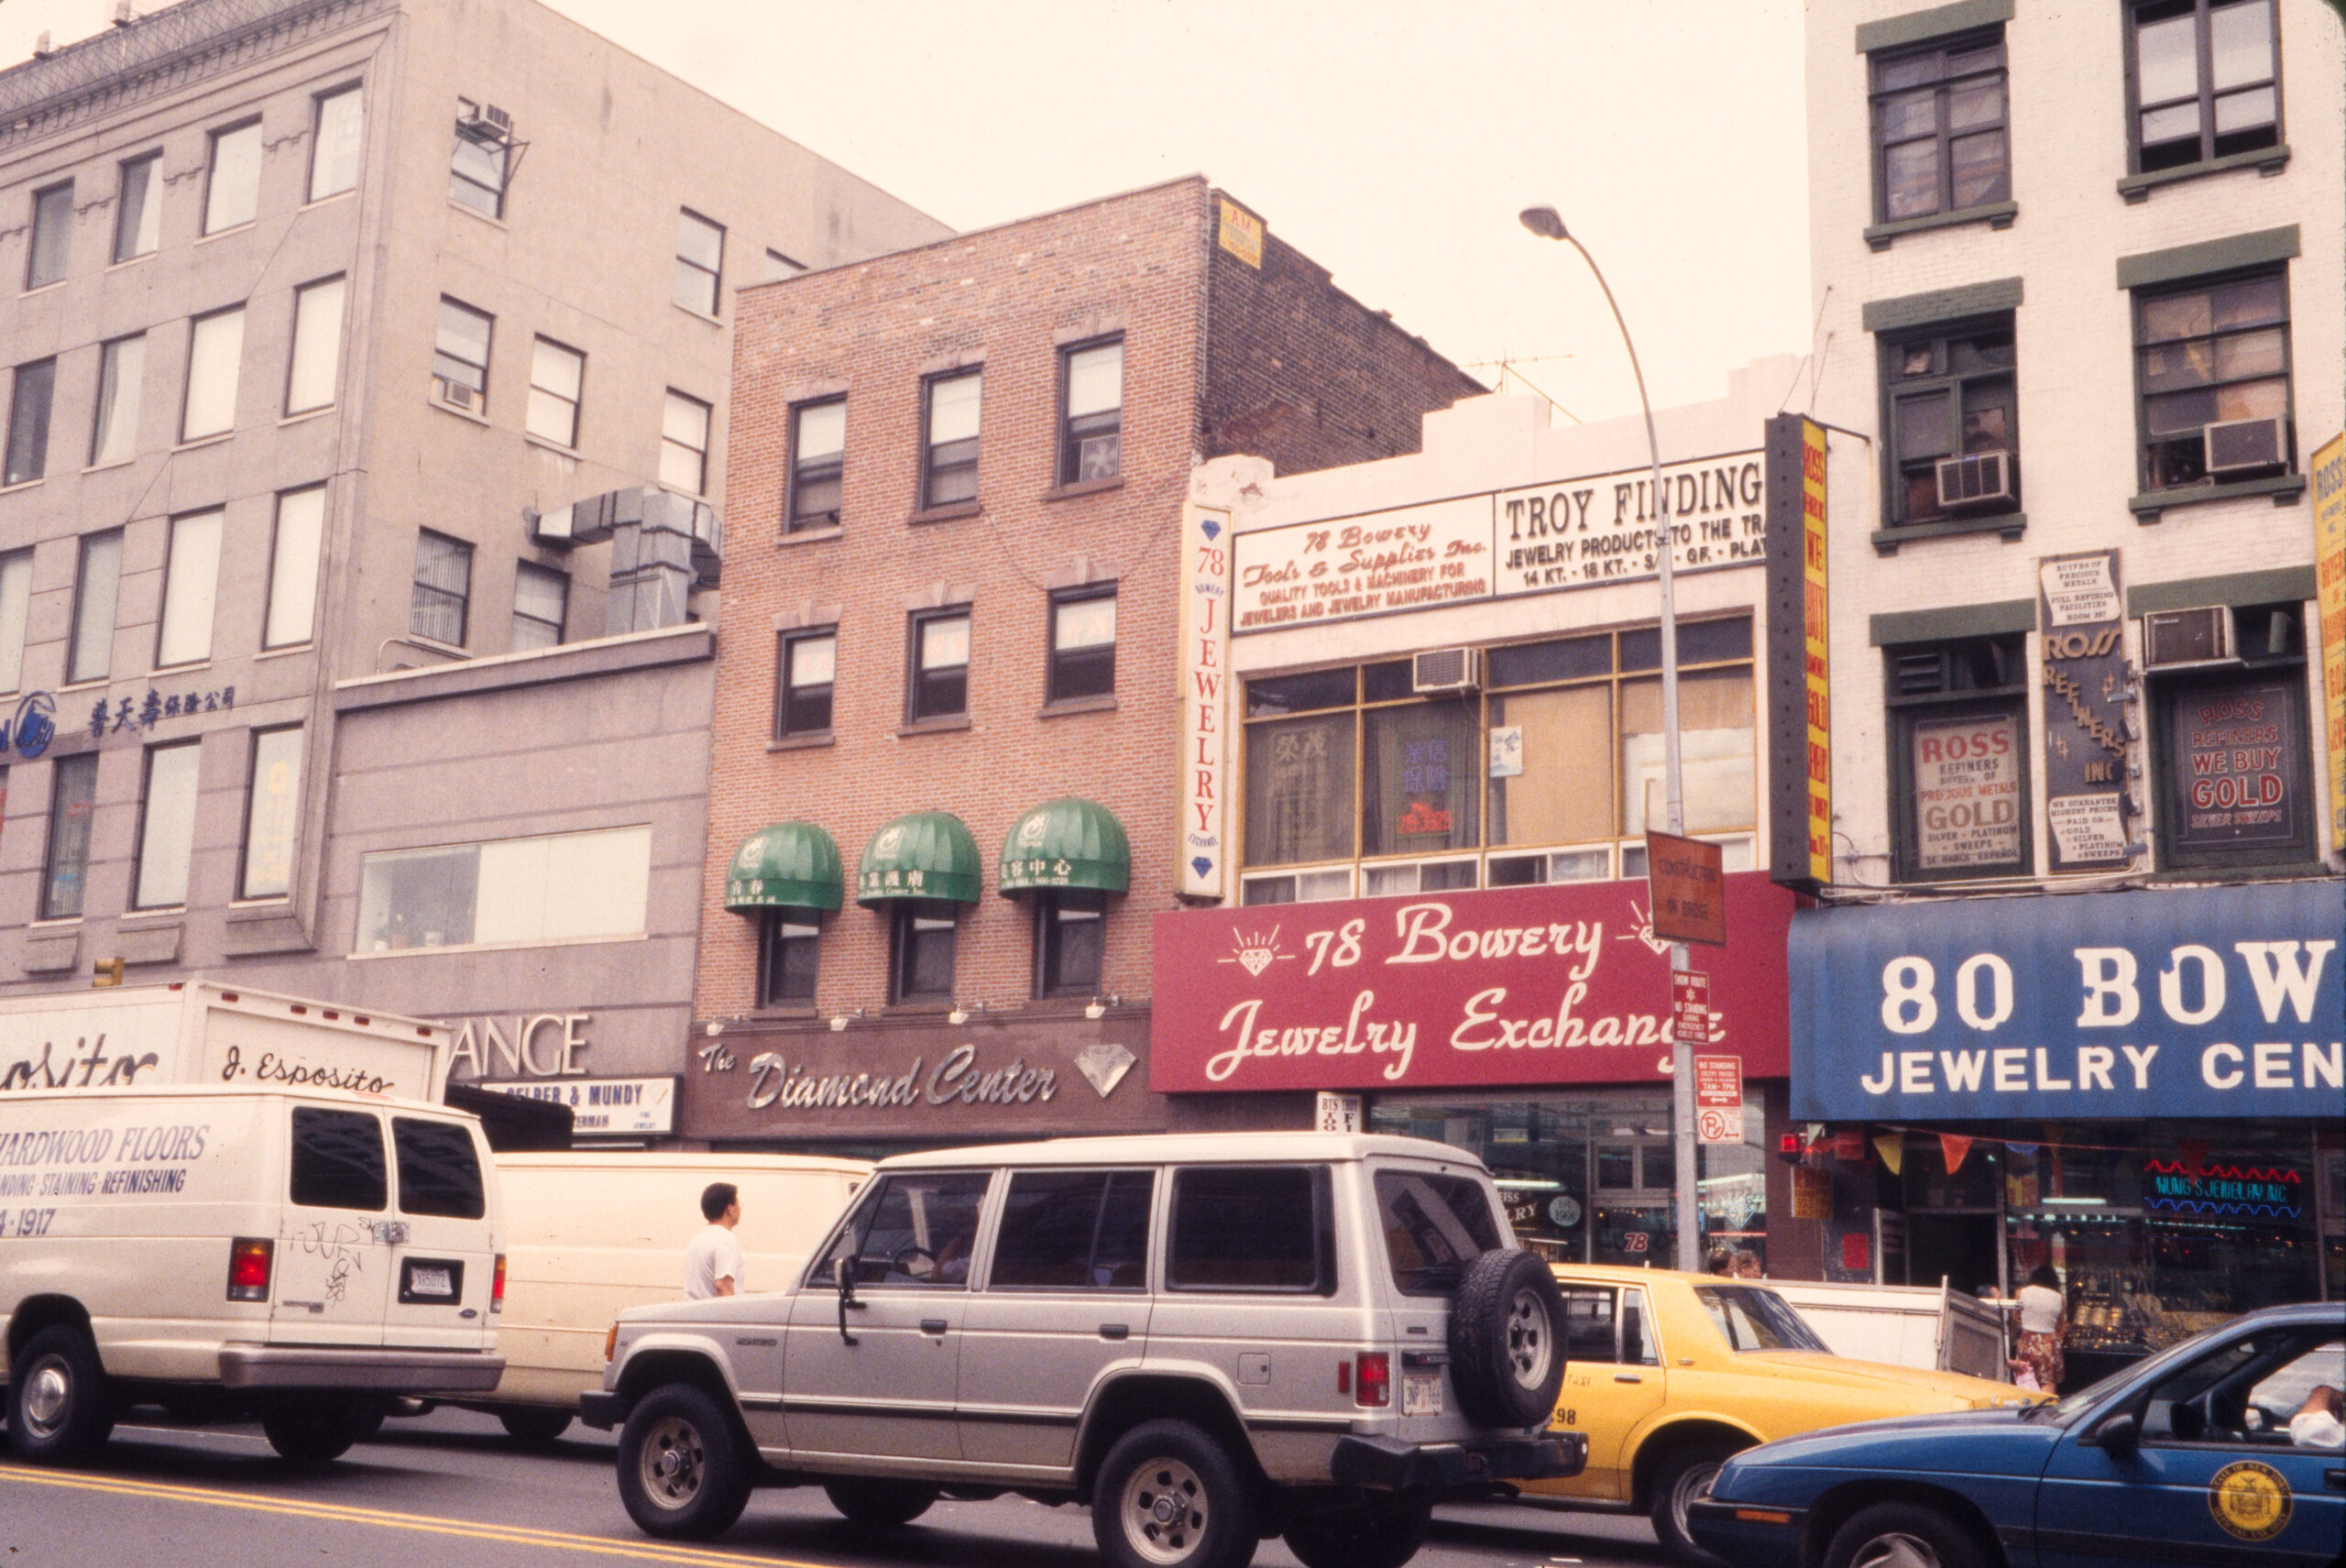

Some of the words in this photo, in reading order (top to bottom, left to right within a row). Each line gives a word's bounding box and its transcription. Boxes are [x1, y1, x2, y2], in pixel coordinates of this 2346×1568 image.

[2316, 456, 2343, 502] ROSS
[1506, 488, 1595, 541] TROY
[1614, 462, 1762, 525] FINDING
[1304, 530, 1331, 554] 78
[1337, 523, 1431, 550] Bowery
[1506, 542, 1573, 569] JEWELRY
[1581, 528, 1666, 558] PRODUCTS
[1671, 524, 1692, 544] TO
[1700, 518, 1732, 542] THE
[1741, 514, 1766, 536] TR
[1197, 546, 1225, 576] 78
[1244, 560, 1301, 587] Tools
[1310, 561, 1330, 577] &
[1338, 542, 1436, 574] Supplies
[1444, 539, 1487, 558] Inc.
[1523, 570, 1539, 587] 14
[1545, 566, 1567, 584] KT.
[1583, 562, 1598, 579] 18
[1604, 558, 1628, 576] KT.
[1644, 554, 1661, 569] S/
[2091, 560, 2101, 568] OF
[1260, 585, 1308, 607] QUALITY
[1313, 577, 1350, 596] TOOLS
[1354, 577, 1363, 592] &
[1367, 566, 1435, 590] MACHINERY
[1440, 562, 1465, 579] FOR
[2059, 570, 2099, 580] PRECIOUS
[2064, 578, 2097, 587] METALS
[1195, 583, 1225, 598] BOWERY
[1240, 604, 1298, 627] JEWELERS
[1301, 601, 1324, 618] AND
[1328, 594, 1381, 614] JEWELRY
[1387, 577, 1486, 607] MANUFACTURING
[2052, 596, 2071, 604] FULL
[2075, 591, 2114, 601] REFINING
[2060, 600, 2108, 611] FACILITIES
[2066, 612, 2090, 620] ROOM
[2042, 627, 2122, 659] ROSS
[1194, 598, 1222, 831] JEWELRY
[2044, 664, 2126, 758] REFINERS
[2199, 700, 2265, 726] ROSS
[1922, 729, 2010, 763] ROSS
[2192, 726, 2278, 748] REFINERS
[1939, 759, 2000, 775] REFINERS
[2191, 751, 2229, 775] WE
[2233, 747, 2281, 773] BUY
[1921, 787, 1972, 802] PRECIOUS
[1978, 782, 2016, 795] METALS
[2068, 797, 2117, 806] GUARANTEE
[2191, 773, 2284, 809] GOLD
[1925, 799, 2014, 831] GOLD
[2051, 807, 2086, 817] HIGHEST
[1927, 832, 1957, 842] SILVER
[1971, 827, 2017, 838] PLATINUM
[1954, 839, 1992, 850] SWEEPS
[2073, 834, 2105, 842] SILVER
[2079, 842, 2123, 850] PLATINUM
[2083, 850, 2121, 858] SWEEPS
[1306, 919, 1365, 976] 78
[1385, 902, 1603, 981] Bowery
[1691, 976, 1707, 988] ROUTE
[1881, 953, 2014, 1035] 80
[2073, 940, 2337, 1027] BOW
[1674, 1001, 1683, 1013] NO
[1683, 1003, 1708, 1015] STANDING
[446, 1014, 589, 1077] ANGE
[1205, 991, 1418, 1081] Jewelry
[223, 1045, 246, 1080] J.
[257, 1053, 395, 1093] Esposito
[698, 1044, 736, 1073] The
[747, 1052, 923, 1111] Diamond
[926, 1044, 1058, 1105] Center
[1699, 1061, 1707, 1069] NO
[1709, 1062, 1736, 1070] STANDING
[1860, 1045, 2160, 1094] JEWELRY
[2201, 1041, 2345, 1091] CEN
[570, 1087, 579, 1105] &
[588, 1084, 643, 1106] MUNDY
[115, 1125, 211, 1163] FLOORS
[39, 1171, 98, 1196] STAINING
[101, 1168, 187, 1194] REFINISHING
[1624, 1232, 1649, 1252] 78
[1567, 1375, 1591, 1387] TAXI
[1551, 1407, 1576, 1426] 98
